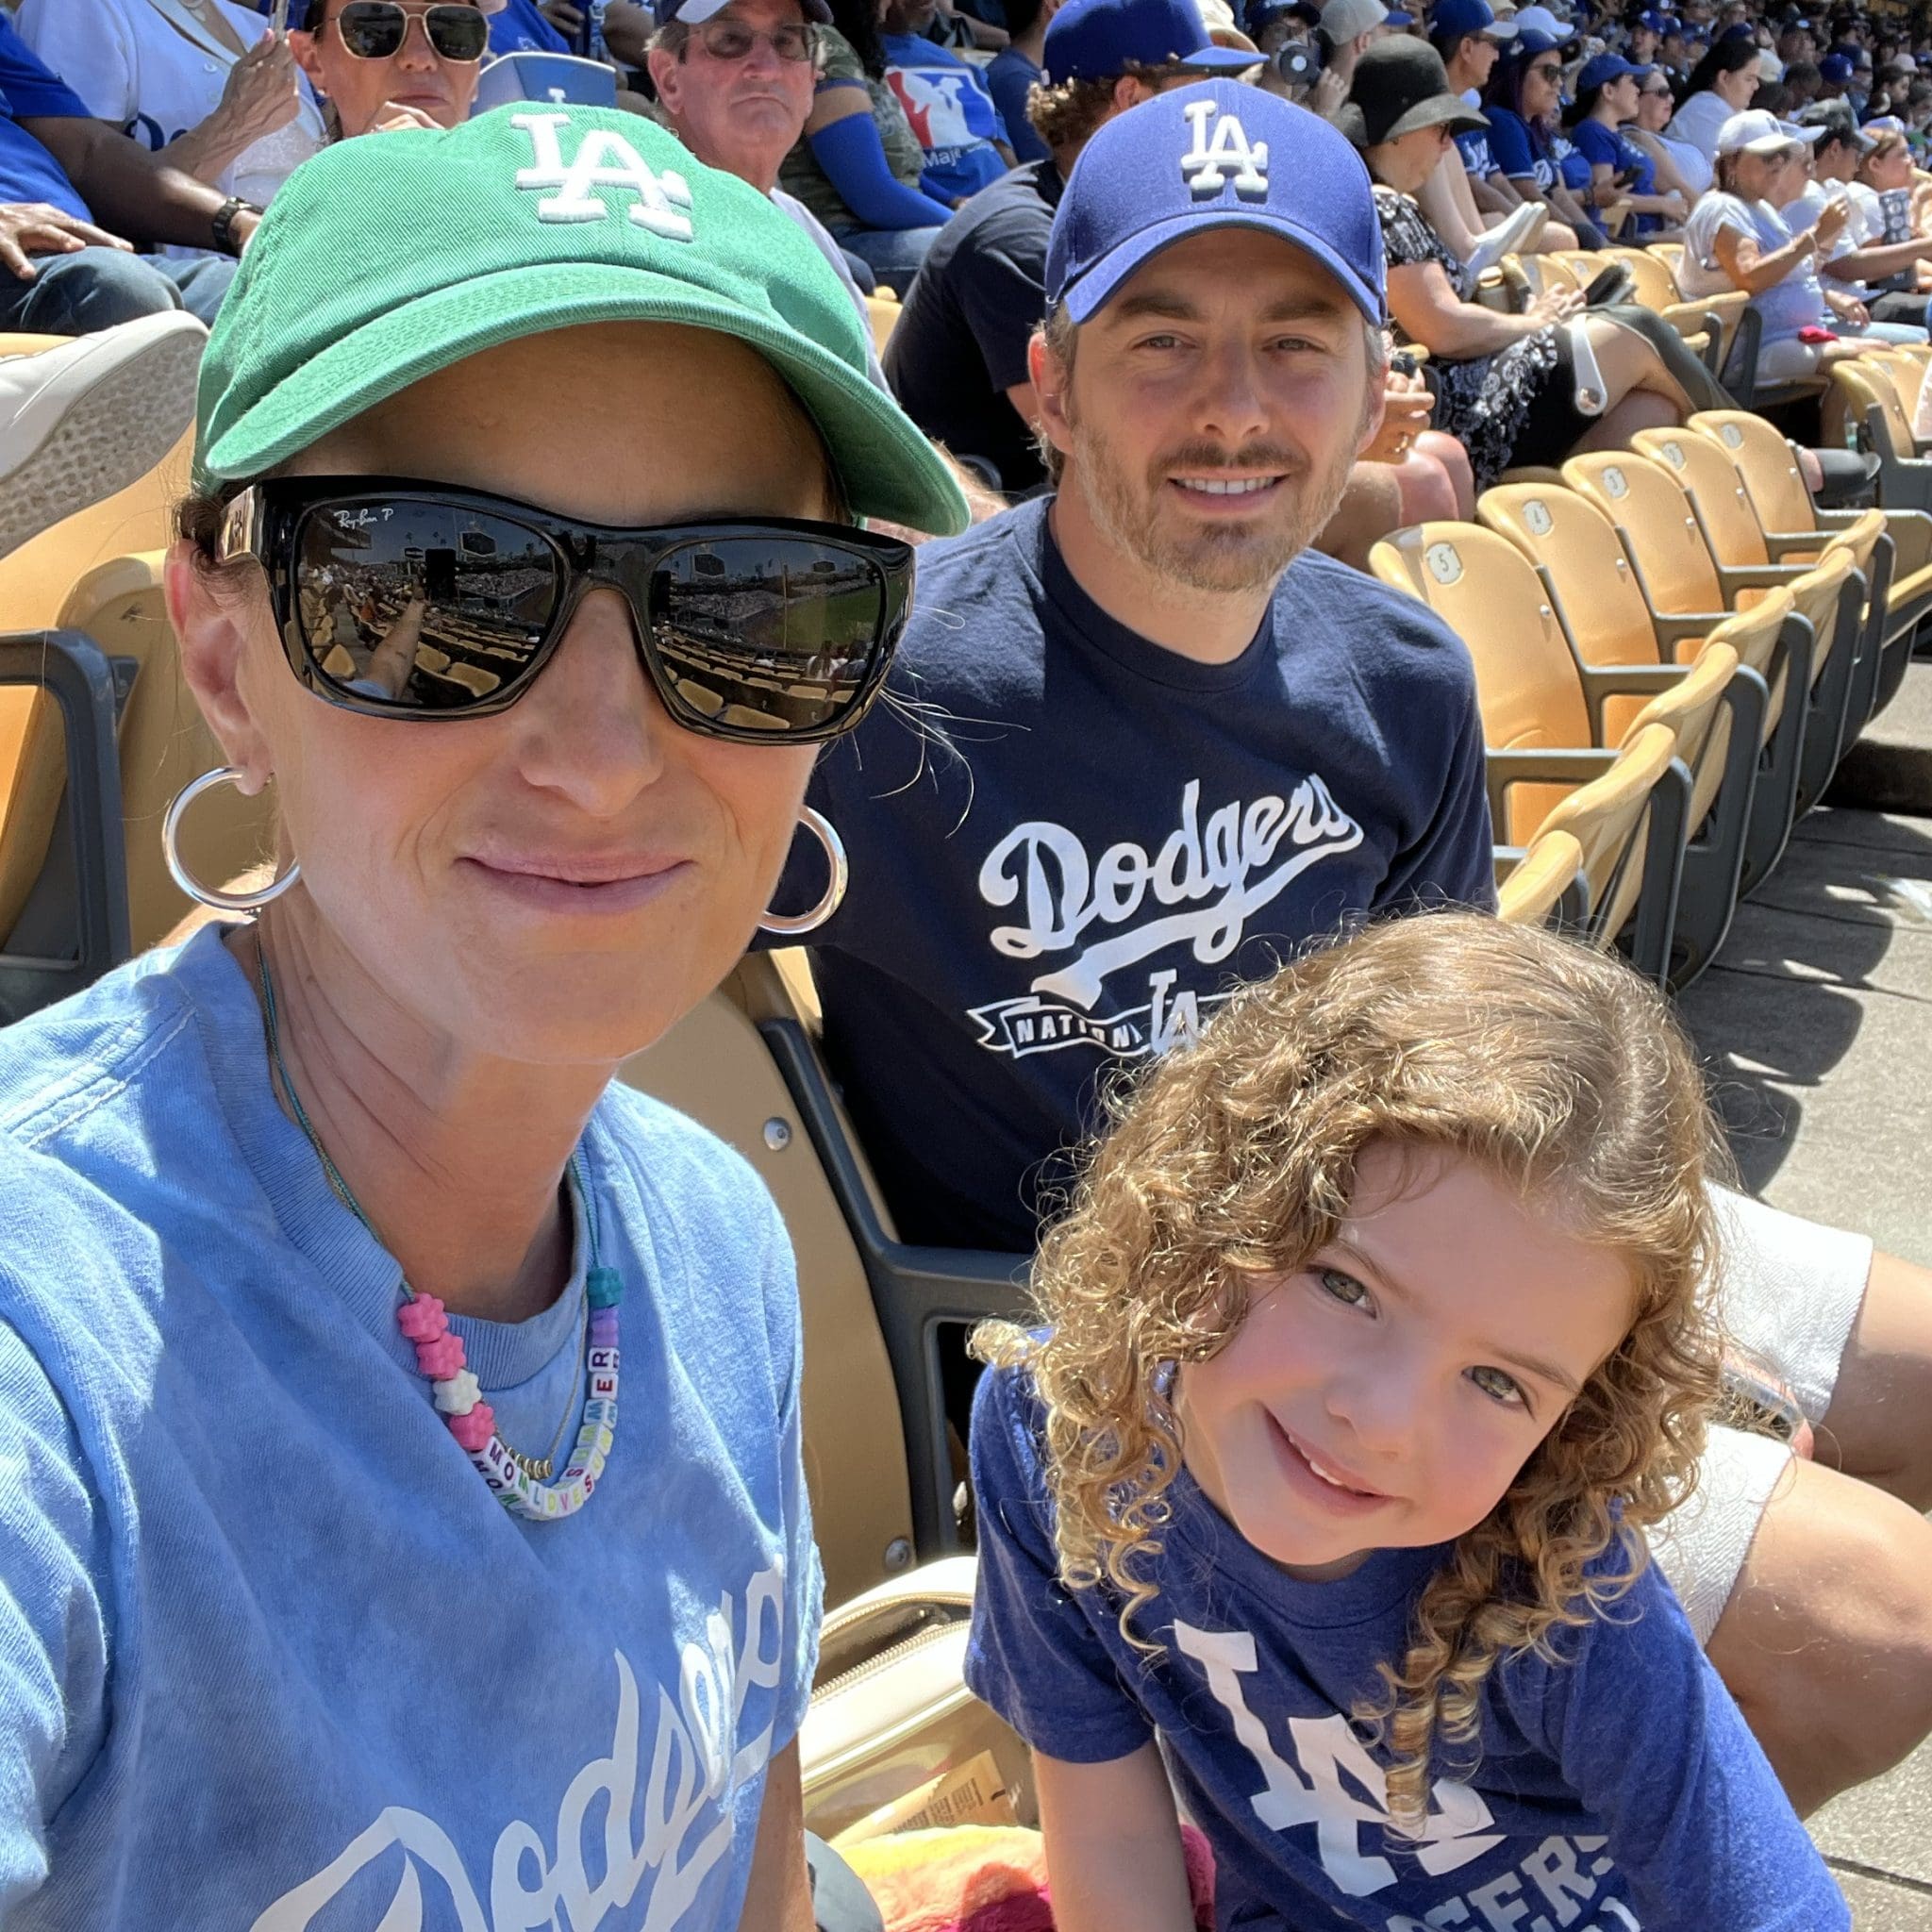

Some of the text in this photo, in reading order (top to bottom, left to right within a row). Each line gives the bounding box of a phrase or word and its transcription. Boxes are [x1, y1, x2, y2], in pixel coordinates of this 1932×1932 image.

[510, 112, 694, 242] LA
[1181, 99, 1269, 197] LA
[333, 508, 394, 529] Ray-Ban P
[978, 773, 1364, 1000] Dodgers
[1174, 1619, 1507, 1896] LA
